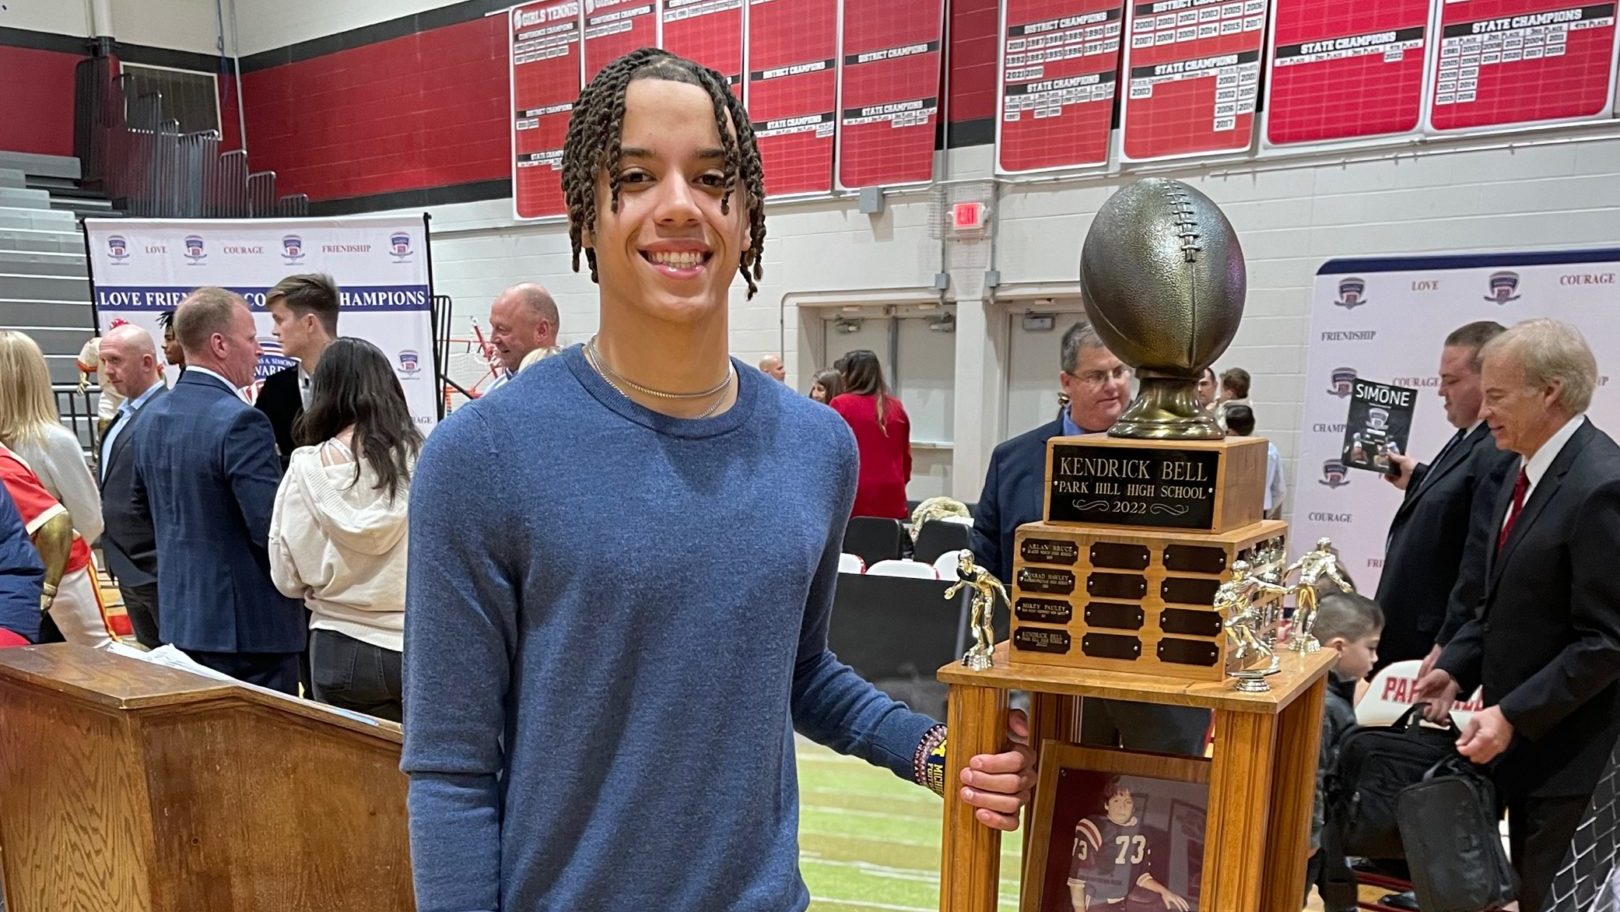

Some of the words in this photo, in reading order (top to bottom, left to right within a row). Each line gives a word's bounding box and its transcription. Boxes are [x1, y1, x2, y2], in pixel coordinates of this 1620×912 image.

[1472, 19, 1511, 33] STATE
[1511, 9, 1582, 29] CHAMPIONS
[1300, 41, 1335, 55] STATE
[1335, 31, 1397, 50] CHAMPIONS
[1154, 62, 1184, 75] STATE
[1185, 54, 1239, 71] CHAMPIONS
[1027, 81, 1052, 93] STATE
[1053, 74, 1100, 89] CHAMPIONS
[862, 106, 883, 117] STATE
[884, 100, 923, 114] CHAMPIONS
[145, 246, 167, 254] LOVE
[223, 246, 264, 255] COURAGE
[322, 244, 371, 254] FRIENDSHIP
[1411, 281, 1440, 291] LOVE
[1559, 273, 1616, 286] COURAGE
[100, 292, 141, 306] LOVE
[340, 291, 425, 306] HAMPIONS
[1321, 331, 1377, 341] FRIENDSHIP
[1392, 377, 1439, 388] COURAGE
[1355, 383, 1411, 407] SIMONE
[1312, 423, 1346, 433] CHAMP
[1059, 457, 1151, 479] KENDRICK
[1161, 460, 1209, 482] BELL
[1058, 480, 1089, 494] PARK
[1095, 482, 1121, 496] HILL
[1127, 483, 1155, 497] HIGH
[1160, 485, 1206, 500] SCHOOL
[1111, 501, 1147, 514] 2022
[1308, 511, 1353, 523] COURAGE
[1381, 677, 1419, 704] PAR
[1114, 834, 1147, 865] 73
